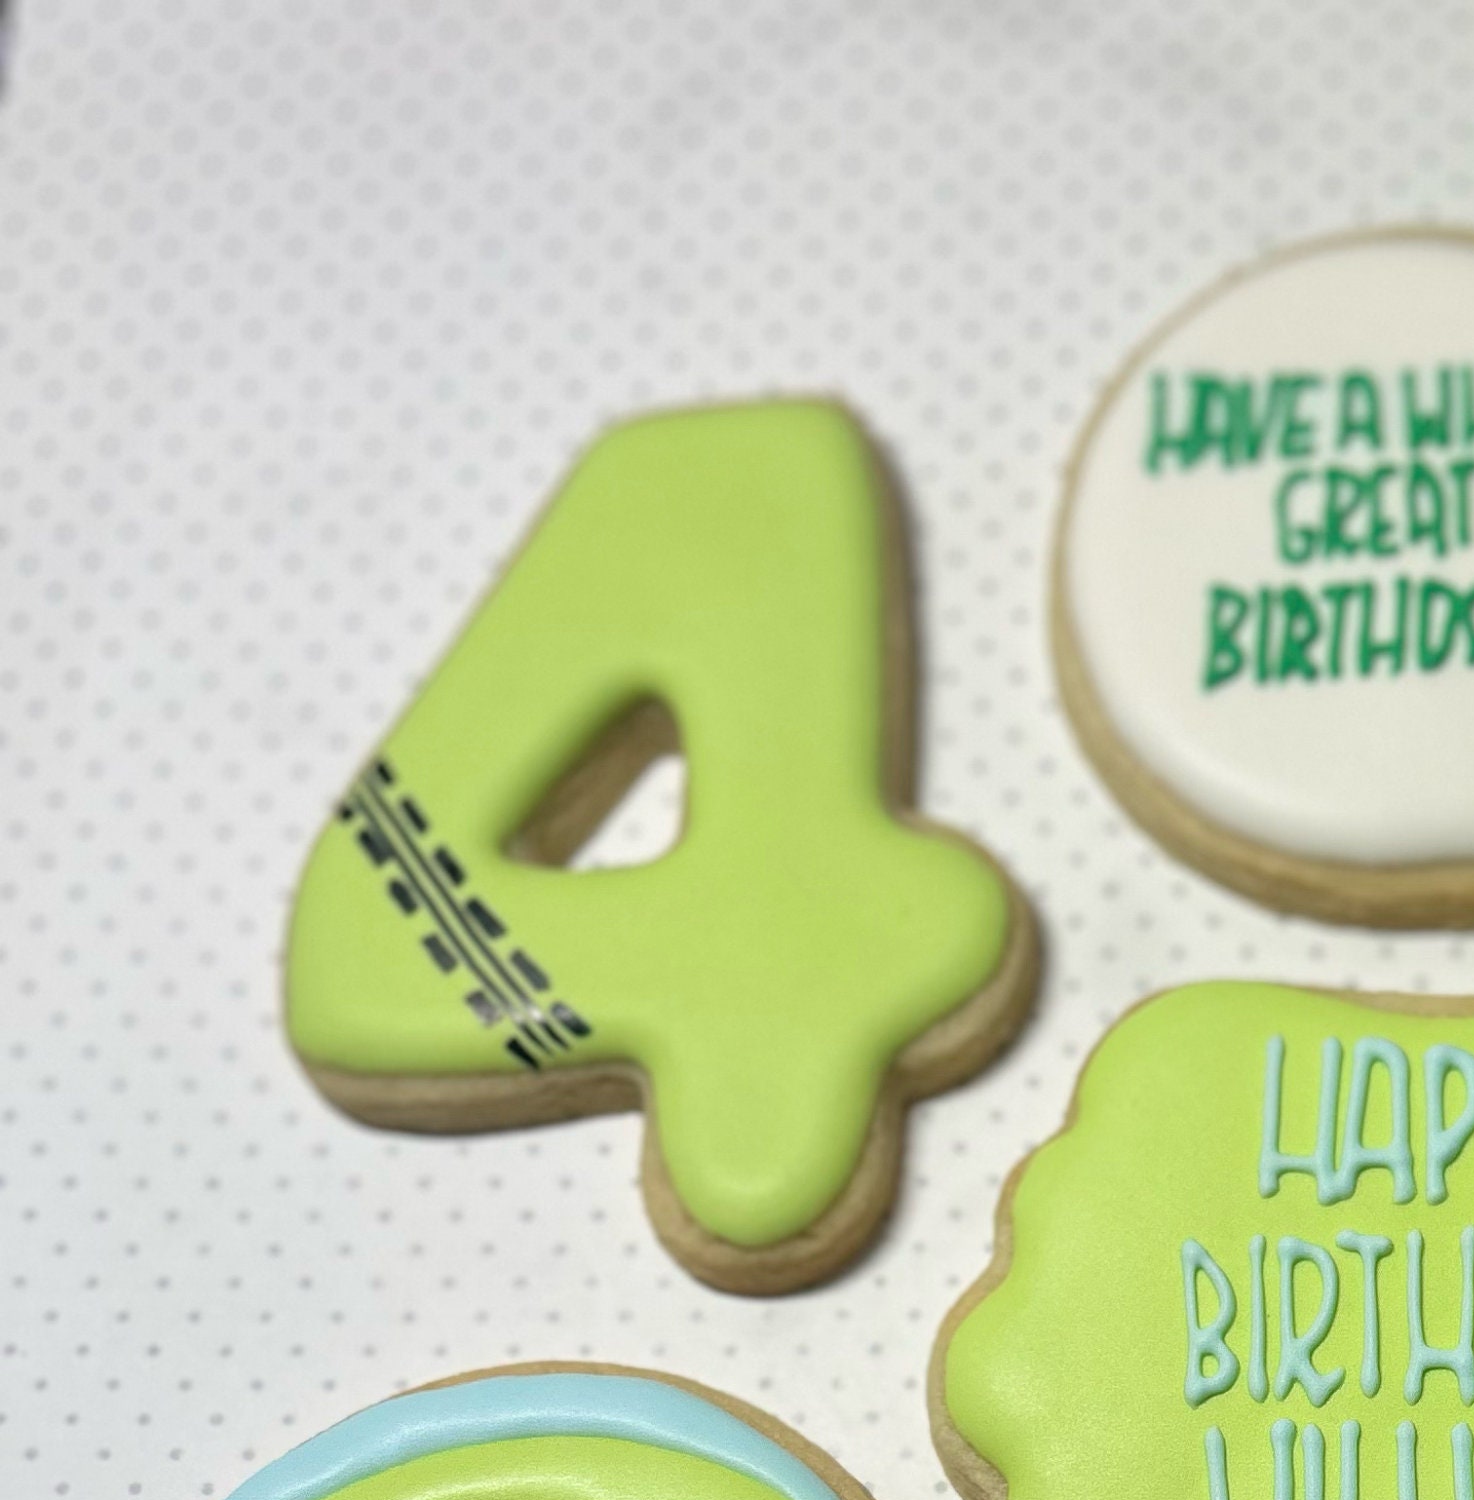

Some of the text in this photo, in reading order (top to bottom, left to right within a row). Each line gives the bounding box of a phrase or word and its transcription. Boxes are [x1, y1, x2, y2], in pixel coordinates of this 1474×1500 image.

[1143, 369, 1322, 474] HAVE
[1333, 369, 1385, 453] A
[282, 395, 1048, 1298] 4
